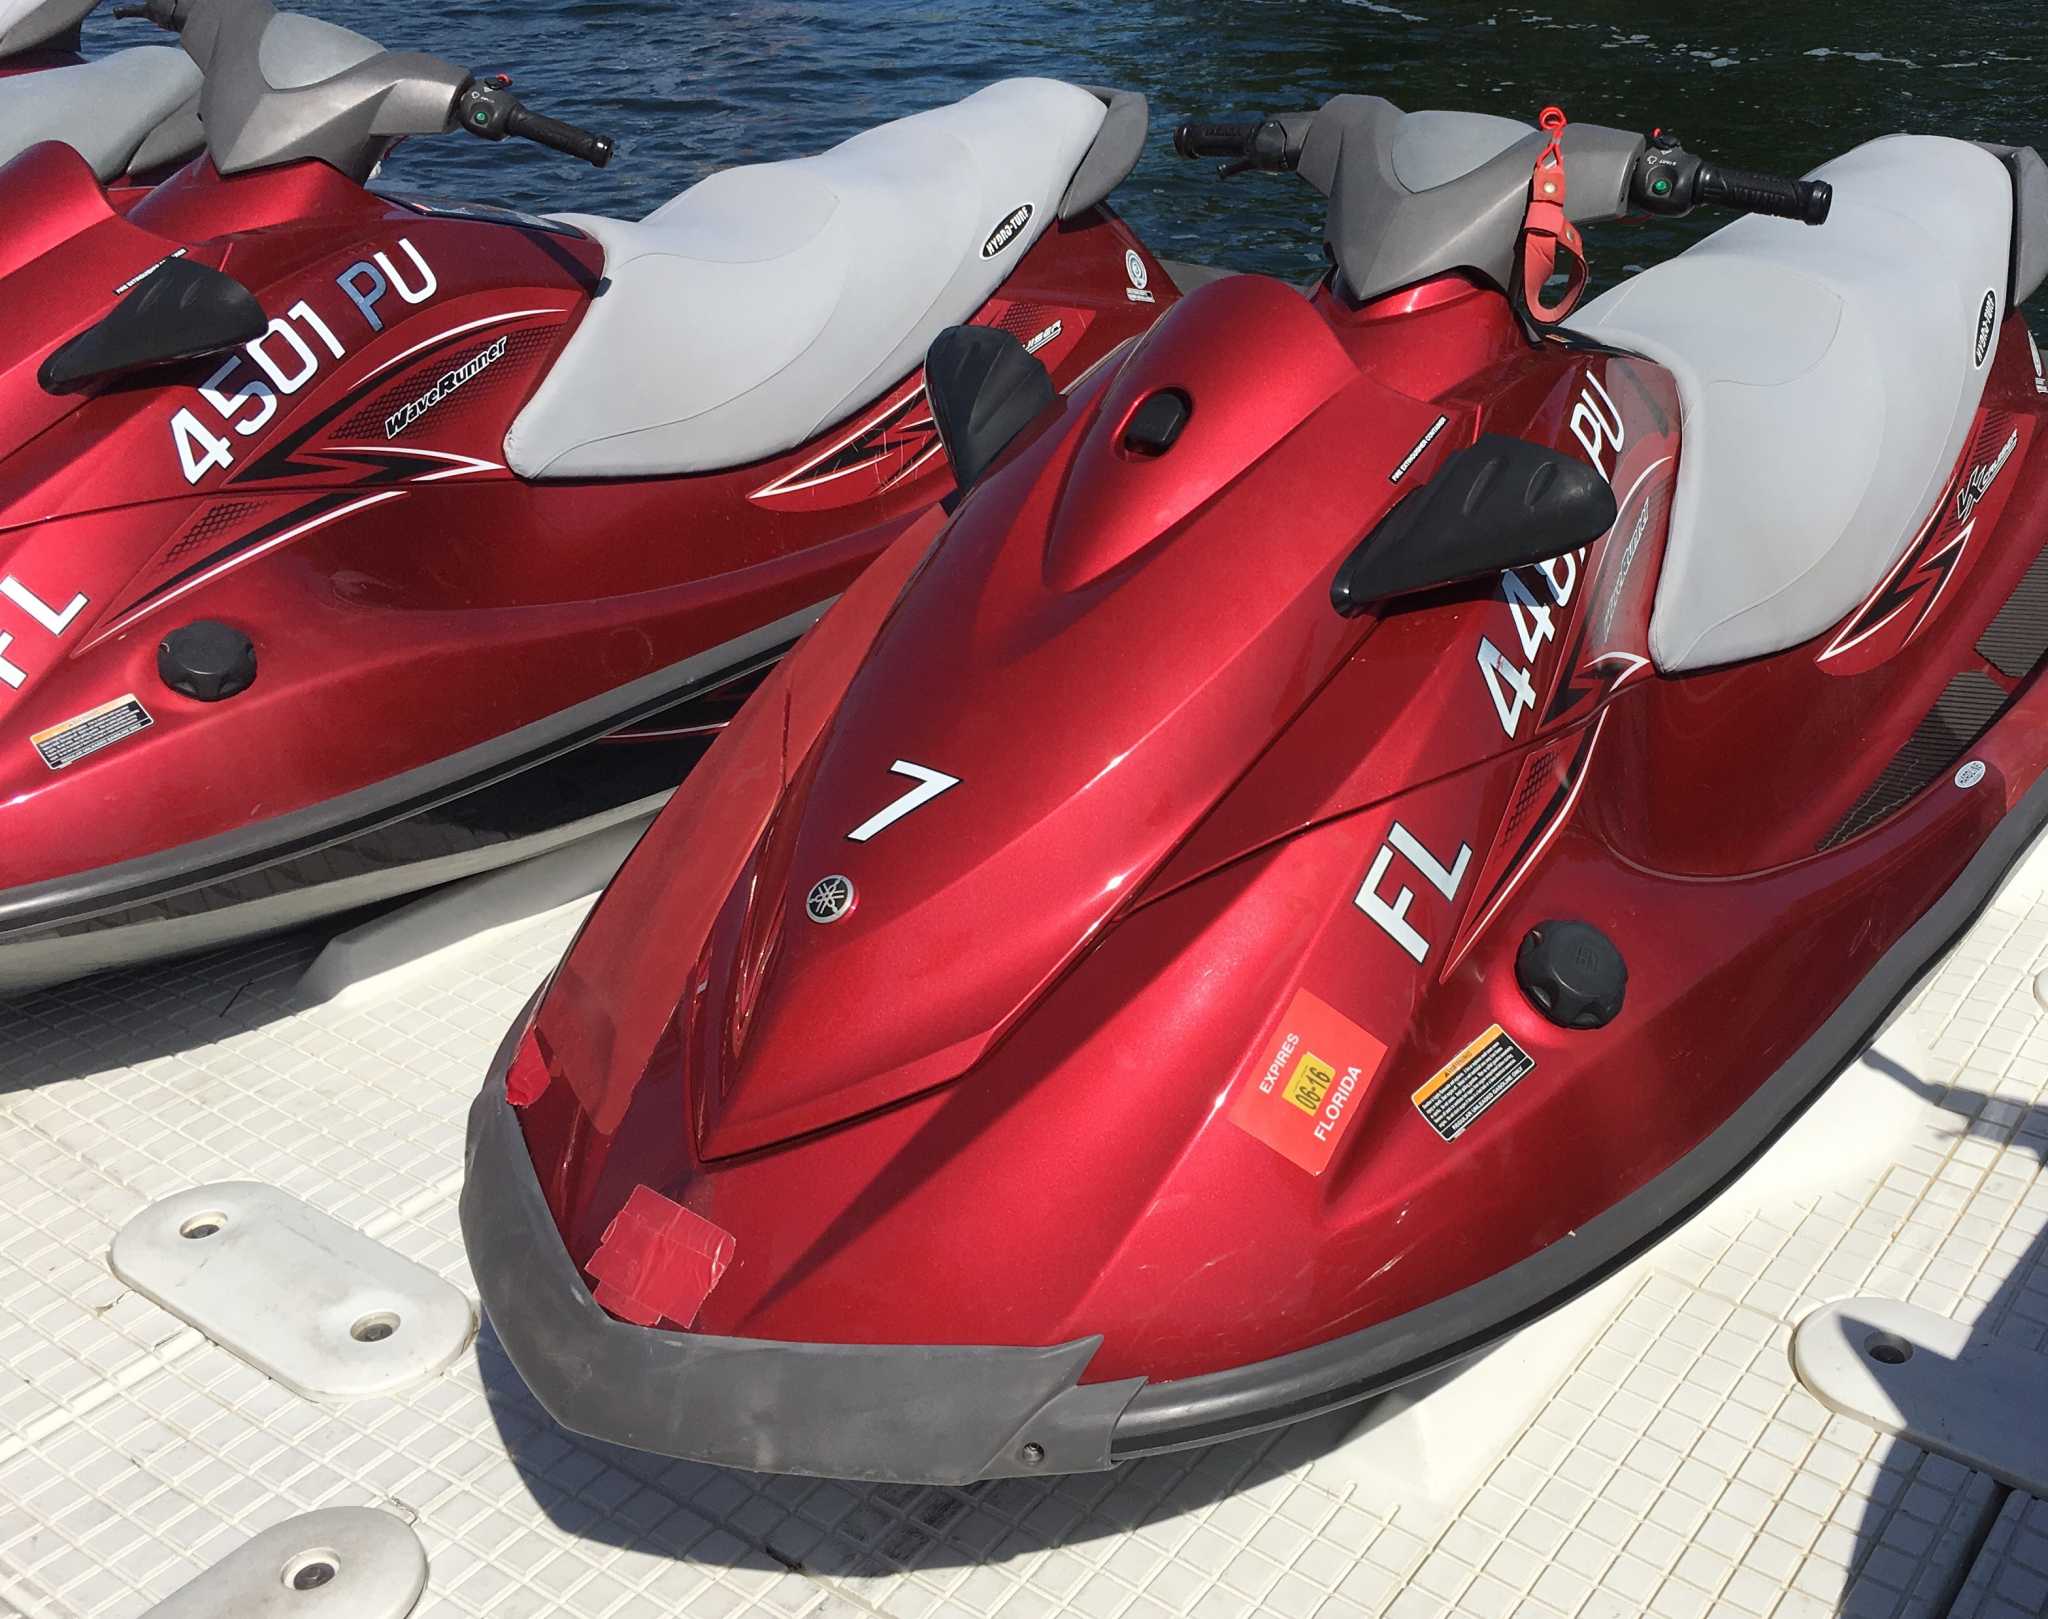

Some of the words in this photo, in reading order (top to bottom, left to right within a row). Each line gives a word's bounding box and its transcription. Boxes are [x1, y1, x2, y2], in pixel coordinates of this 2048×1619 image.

[986, 206, 1029, 255] HYDRO-TURF
[168, 299, 346, 485] 4501
[336, 238, 437, 331] PU
[385, 335, 507, 440] WaveRunner
[1476, 546, 1586, 739] 448
[1569, 369, 1625, 484] PU
[843, 758, 964, 844] 7
[1353, 819, 1473, 965] FL
[1259, 1033, 1300, 1095] EXPIRES
[1313, 1066, 1363, 1142] FLORIDA
